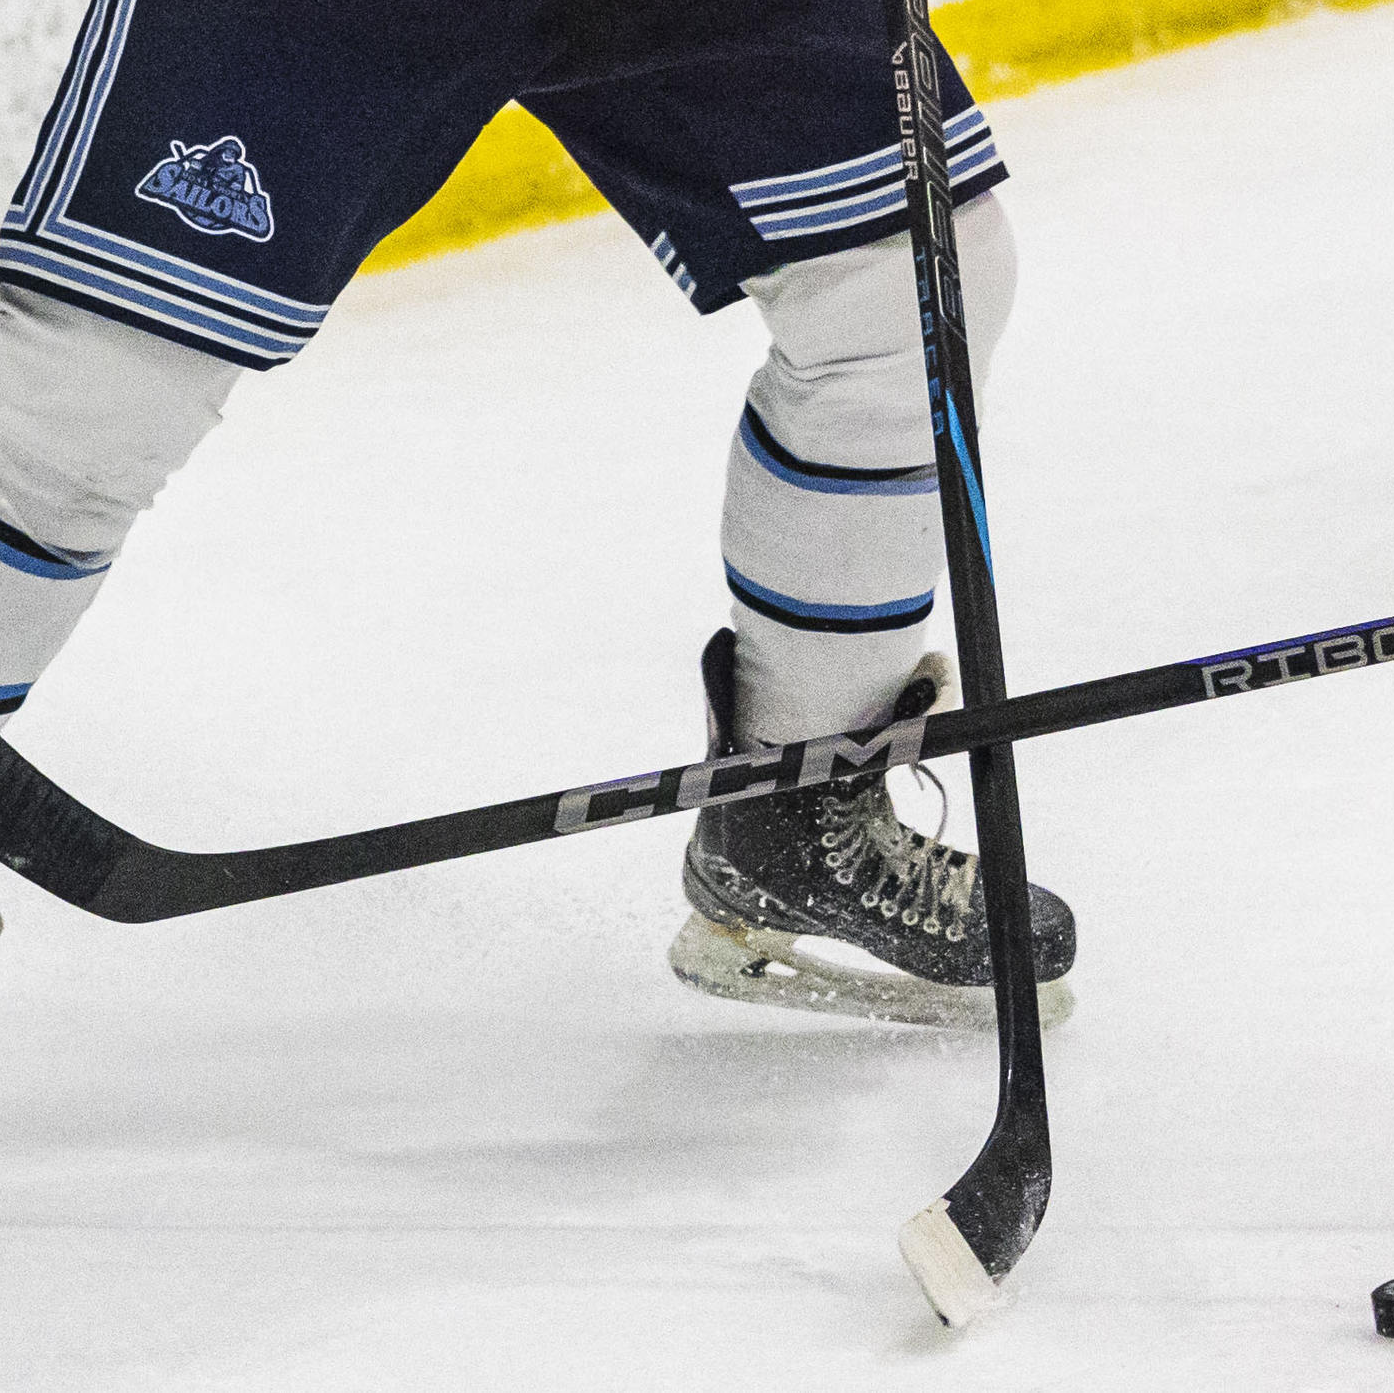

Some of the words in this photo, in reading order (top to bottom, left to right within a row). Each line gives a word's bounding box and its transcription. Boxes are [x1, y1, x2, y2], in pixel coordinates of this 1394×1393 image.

[144, 162, 268, 233] SAILORS
[916, 247, 945, 436] TRACER
[554, 715, 928, 835] CCM
